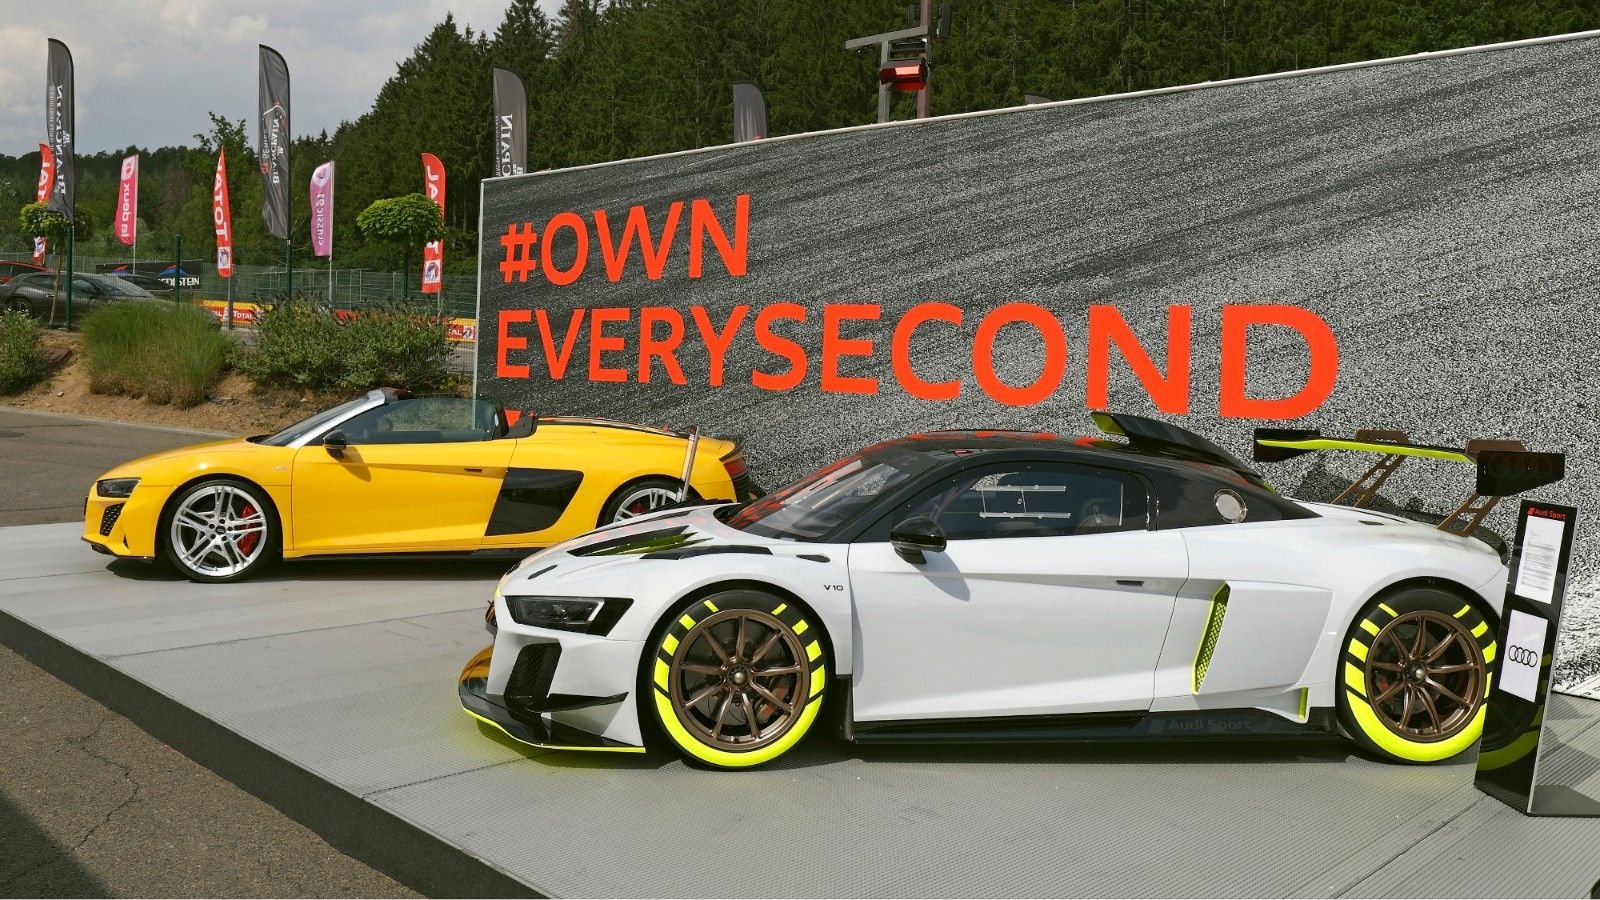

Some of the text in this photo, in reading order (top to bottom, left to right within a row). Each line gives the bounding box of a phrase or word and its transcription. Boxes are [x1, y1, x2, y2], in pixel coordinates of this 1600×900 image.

[499, 194, 751, 286] #OWN
[496, 302, 1340, 420] EVERYSECOND
[1535, 508, 1567, 520] Audi Sport
[1168, 718, 1253, 731] Audi Sport
